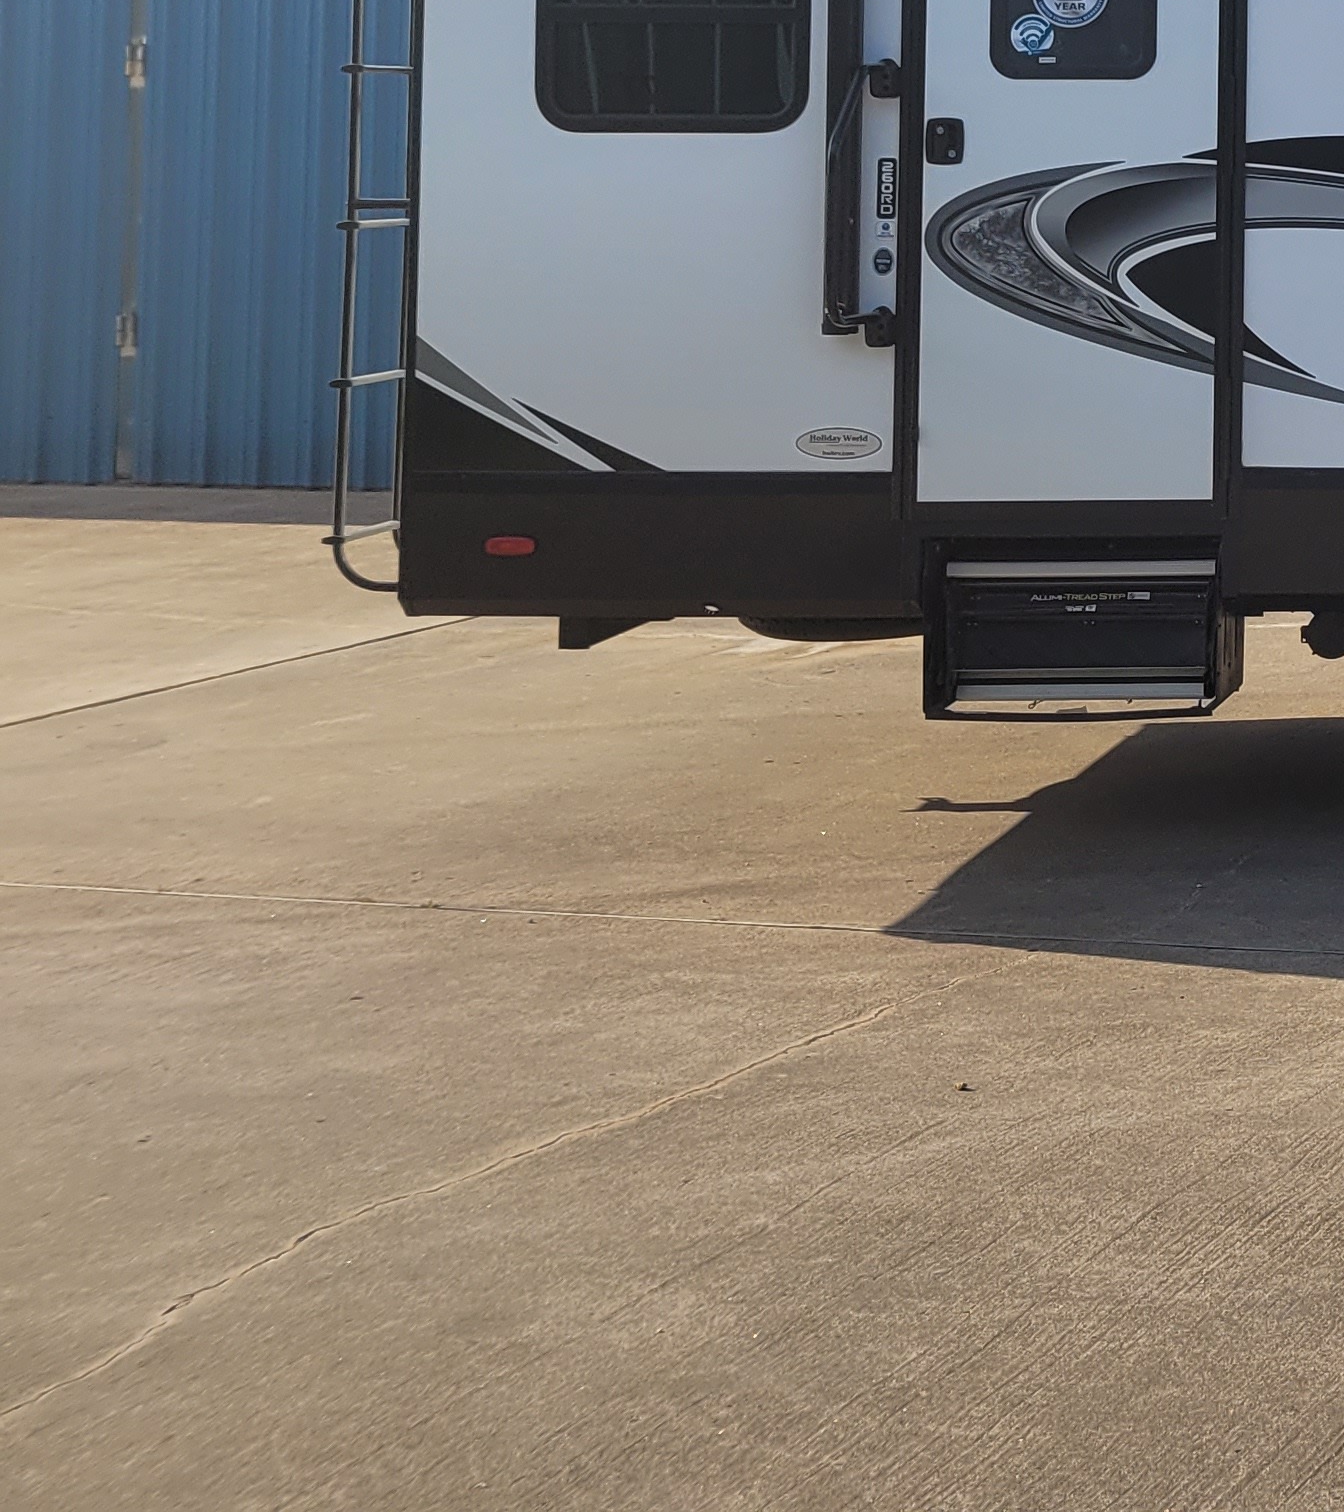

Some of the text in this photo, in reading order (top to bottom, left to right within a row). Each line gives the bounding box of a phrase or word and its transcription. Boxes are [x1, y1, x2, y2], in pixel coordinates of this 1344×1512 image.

[1054, 2, 1086, 11] YEAR
[880, 161, 894, 215] 260RD
[810, 434, 841, 443] Holiday
[1099, 592, 1126, 601] STEP
